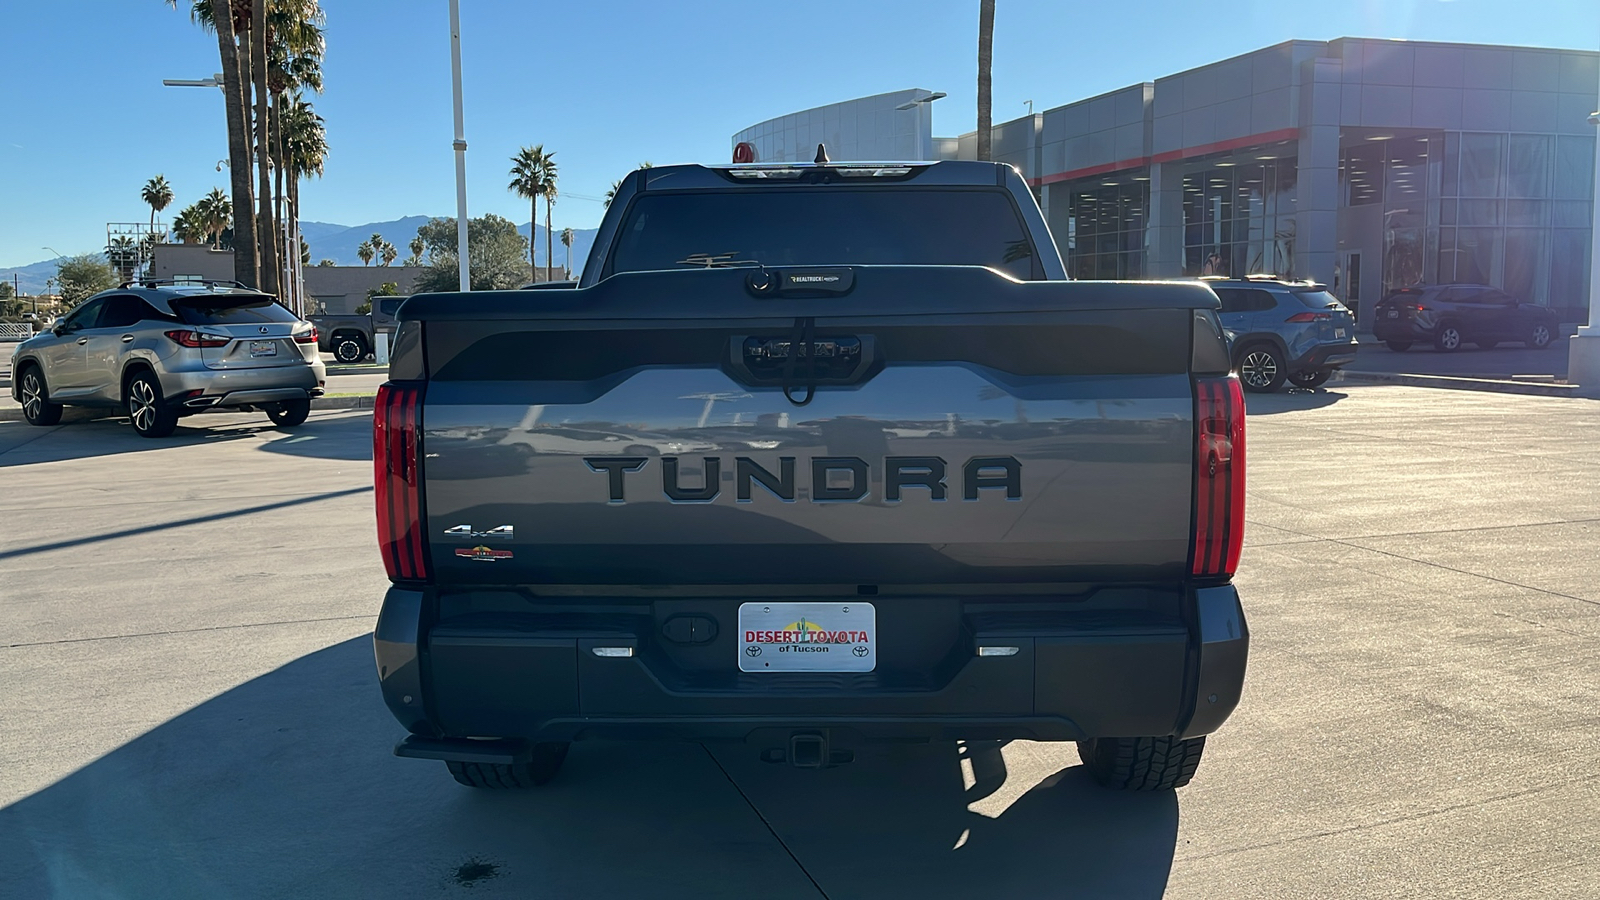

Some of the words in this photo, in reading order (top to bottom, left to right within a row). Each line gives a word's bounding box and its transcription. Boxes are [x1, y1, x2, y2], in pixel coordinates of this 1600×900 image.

[582, 456, 1022, 504] TUNDRA
[745, 630, 801, 643] DESERT
[807, 630, 869, 643] TOYOTA
[779, 645, 791, 653] of
[791, 645, 829, 653] Tucson
